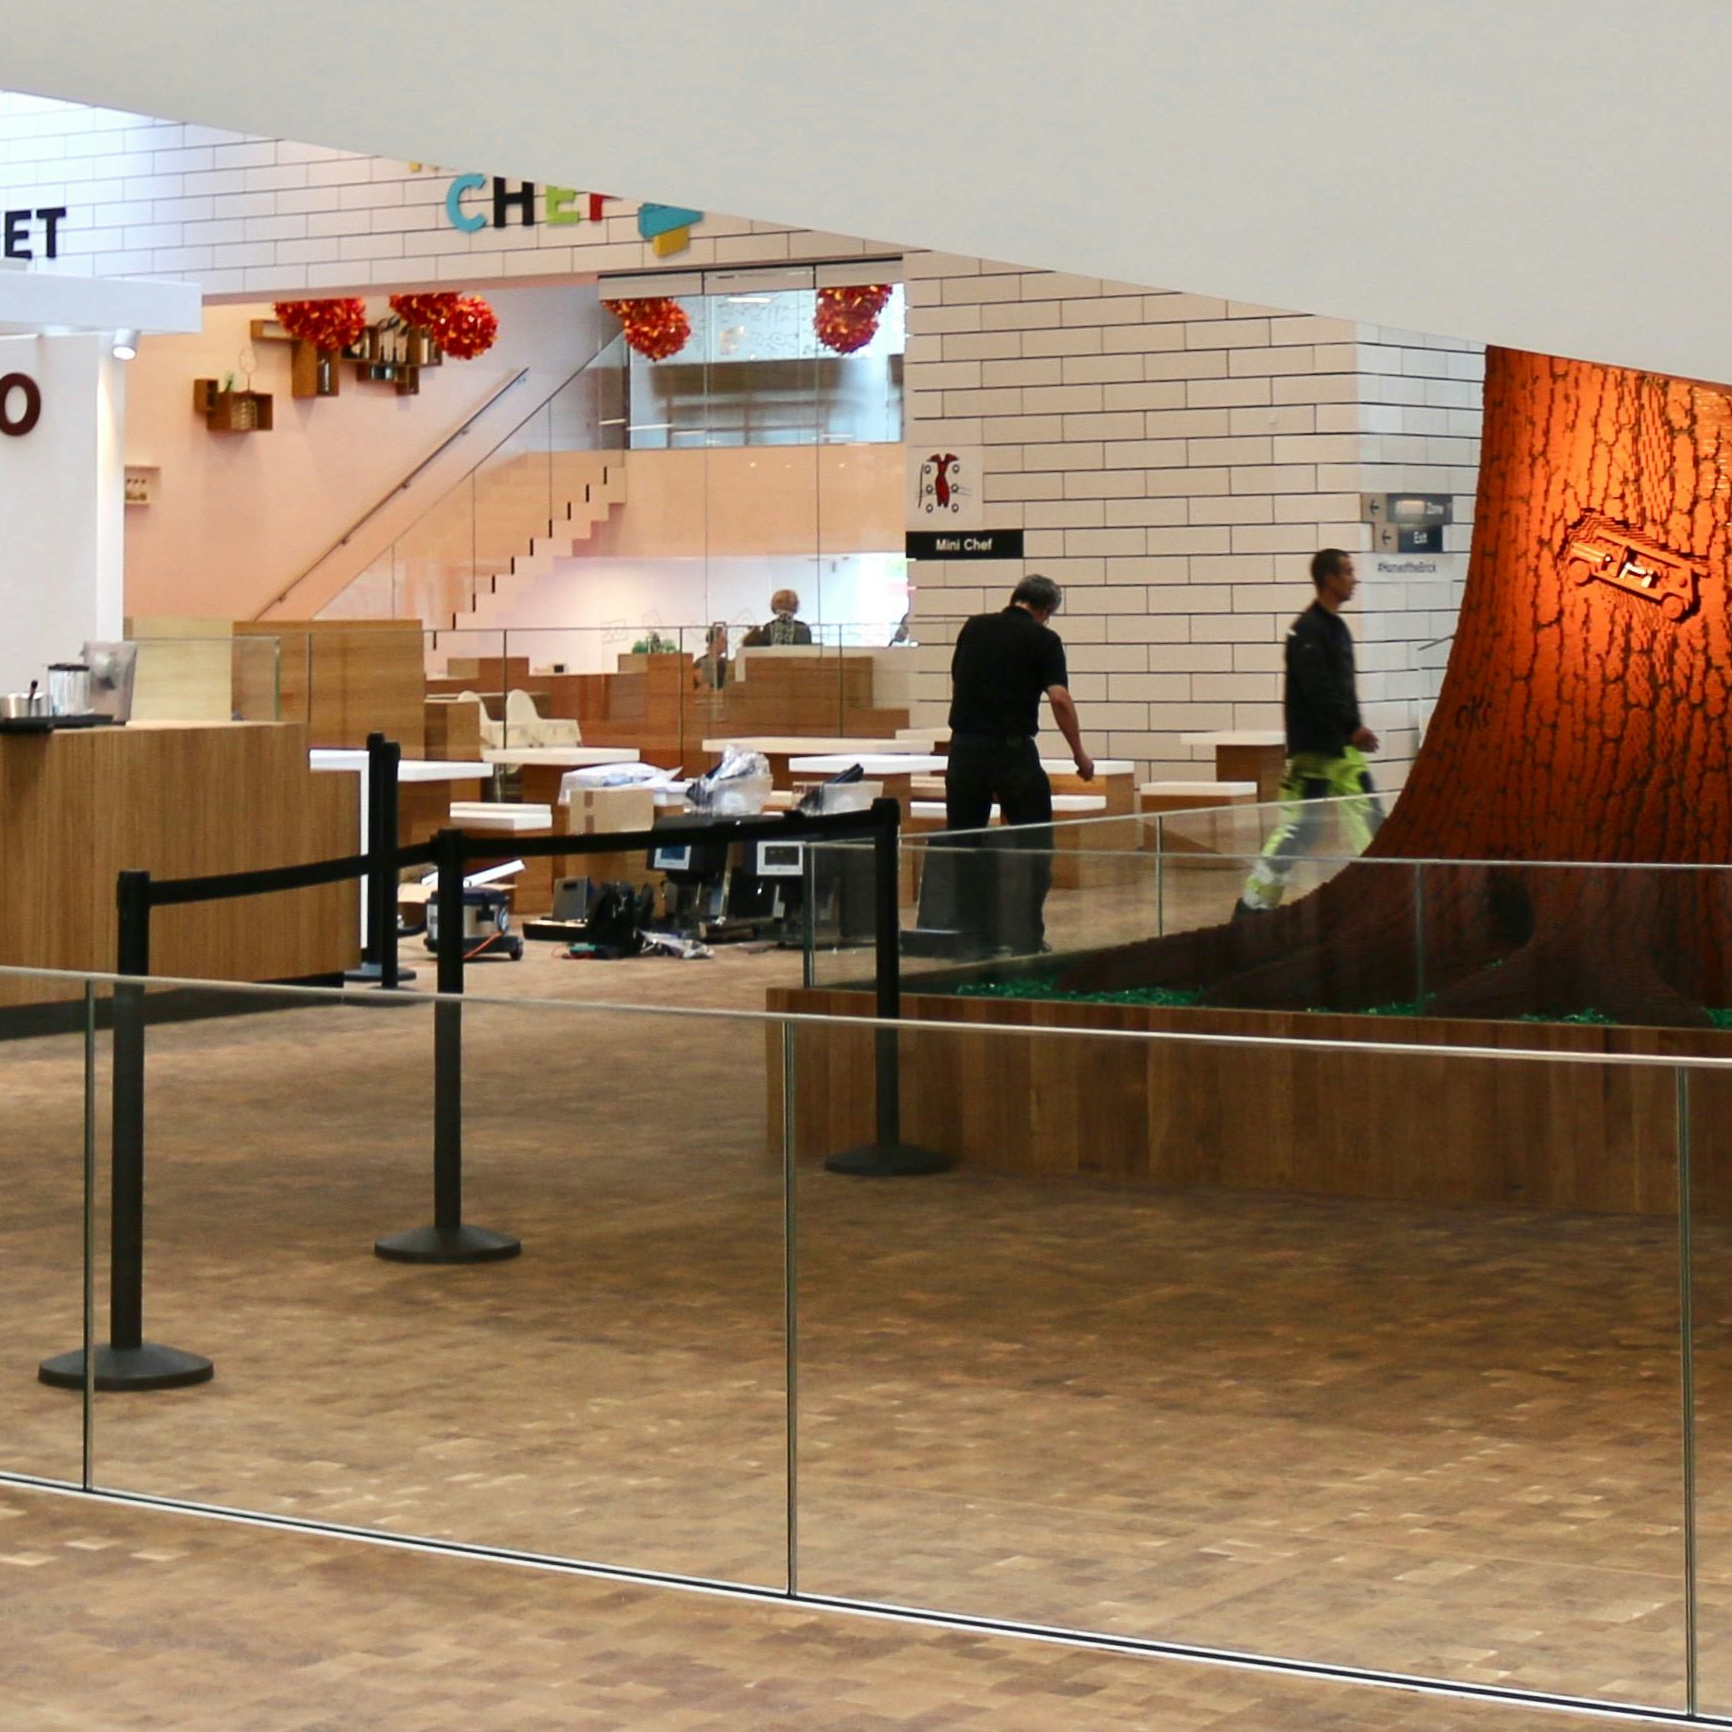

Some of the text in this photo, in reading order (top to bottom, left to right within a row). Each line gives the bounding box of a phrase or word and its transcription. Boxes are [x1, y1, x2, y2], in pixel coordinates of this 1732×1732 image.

[935, 537, 993, 552] Mini Chef
[1413, 530, 1428, 545] Exit
